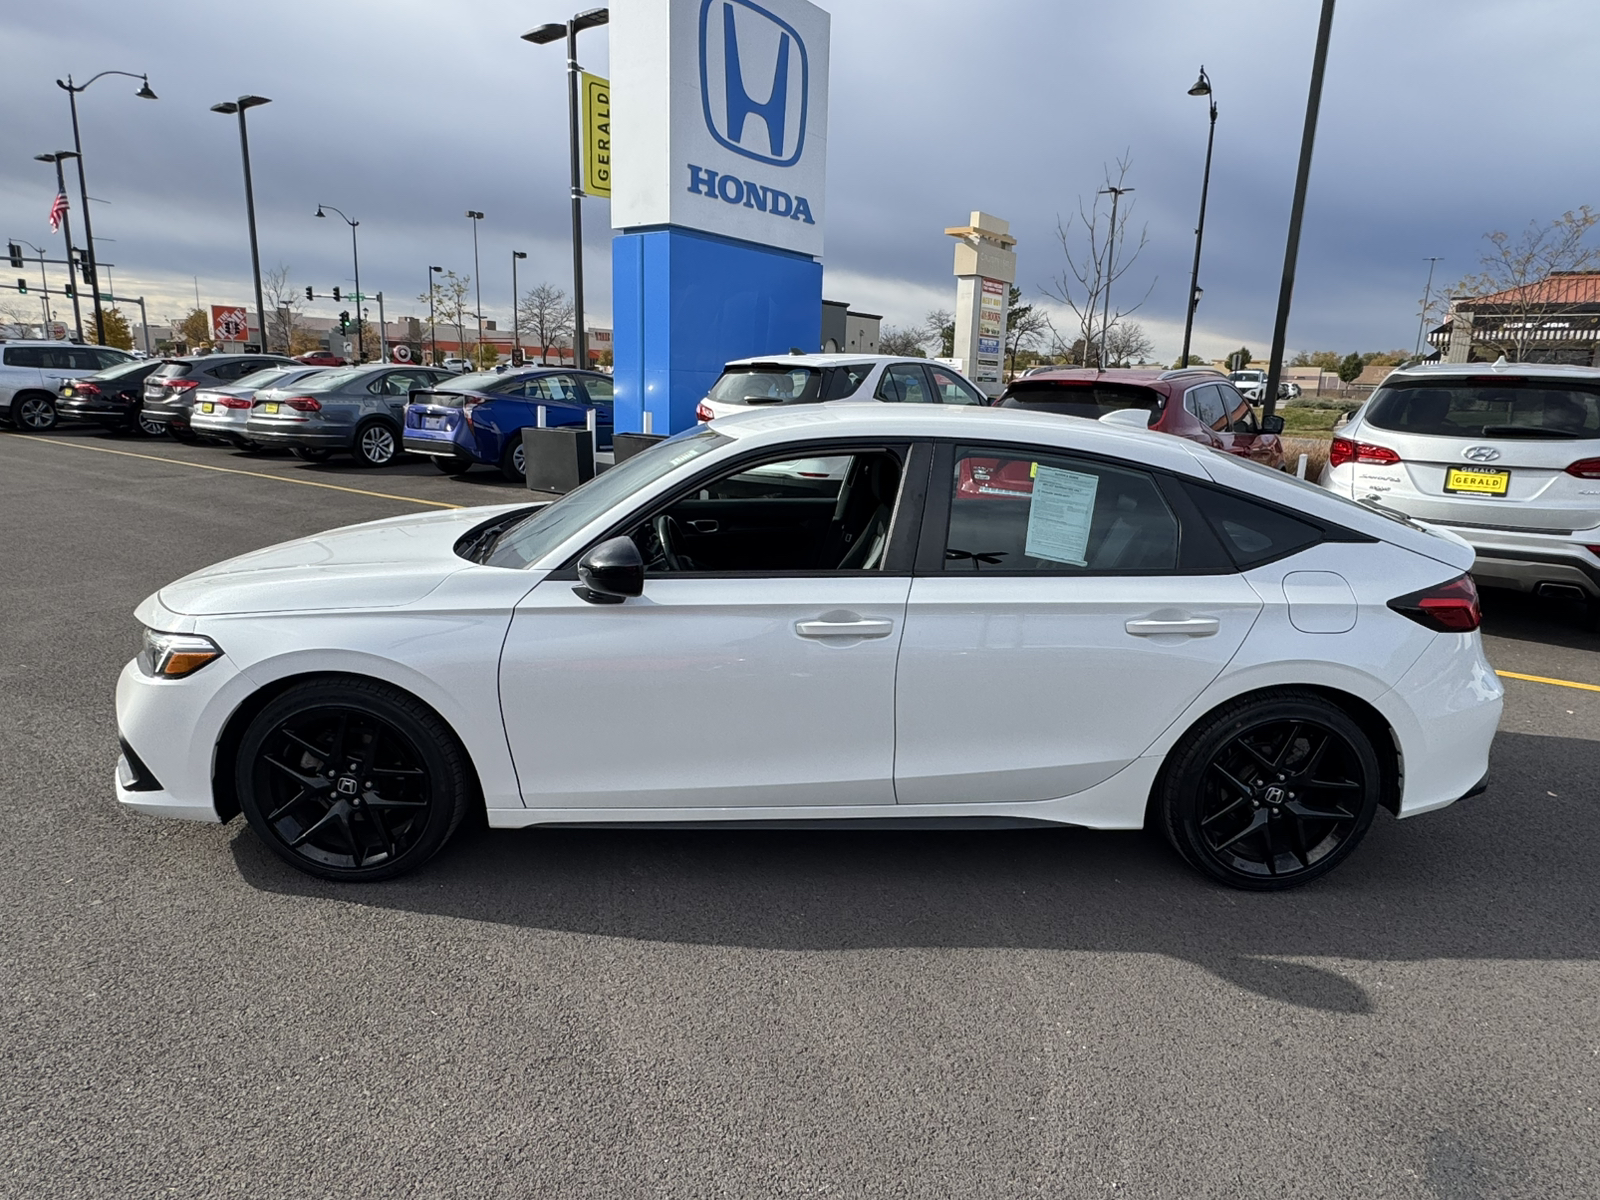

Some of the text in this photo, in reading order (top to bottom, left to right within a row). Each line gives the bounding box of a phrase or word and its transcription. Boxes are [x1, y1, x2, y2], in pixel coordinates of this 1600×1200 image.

[597, 92, 610, 182] GERALD
[687, 164, 815, 225] HONDA
[216, 310, 231, 324] THE
[1461, 466, 1497, 474] GERALD
[1455, 476, 1499, 487] GERALD
